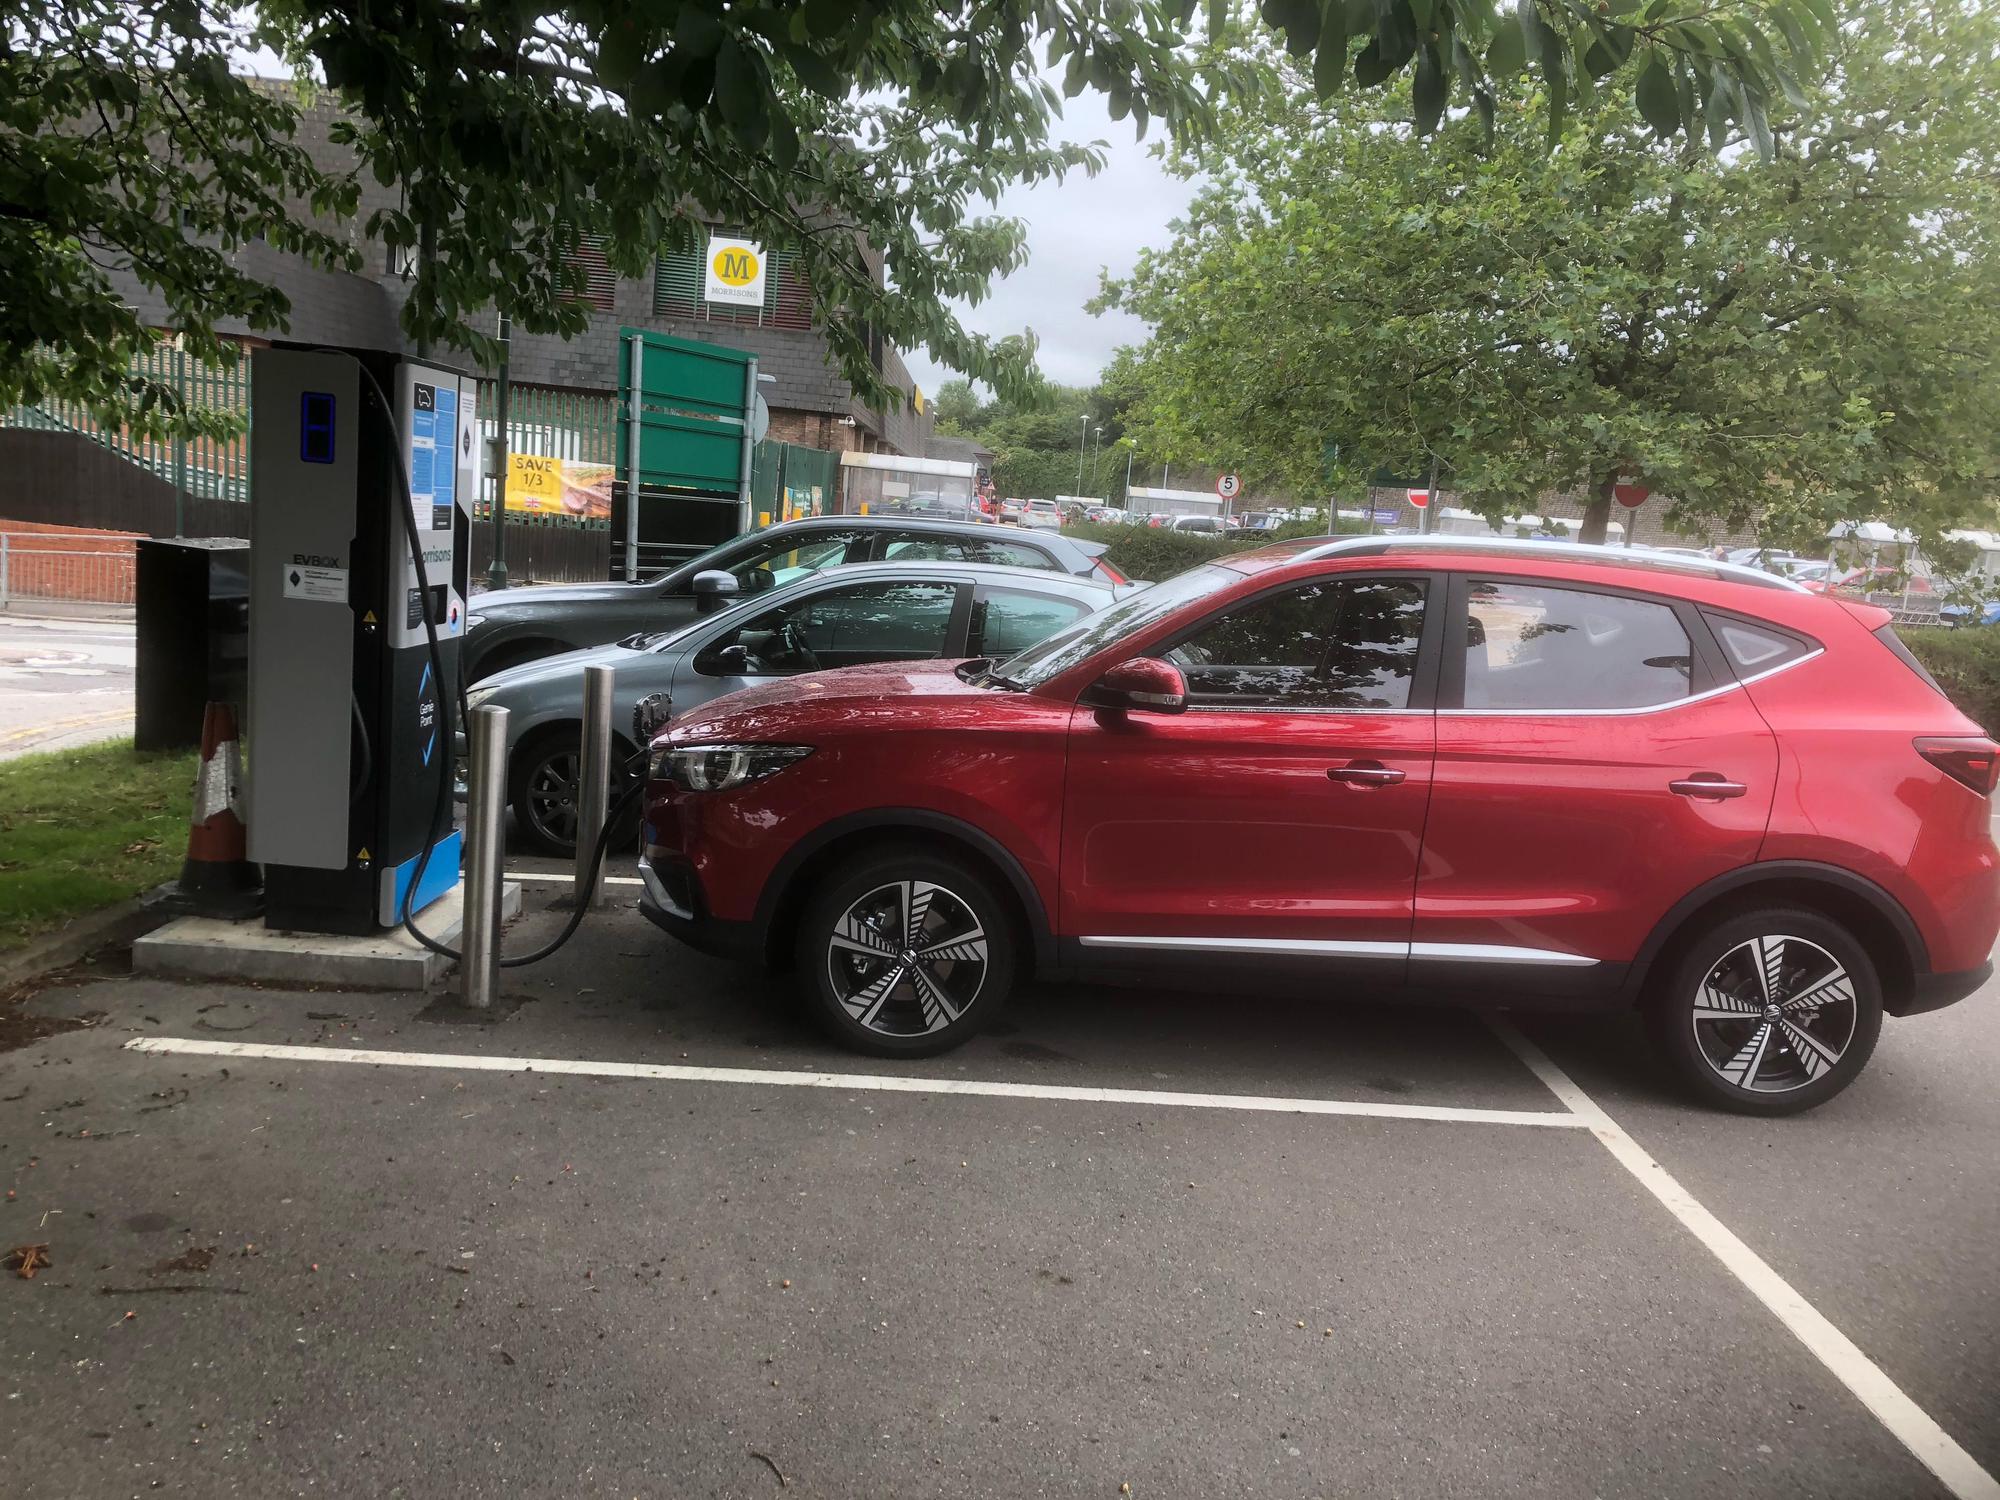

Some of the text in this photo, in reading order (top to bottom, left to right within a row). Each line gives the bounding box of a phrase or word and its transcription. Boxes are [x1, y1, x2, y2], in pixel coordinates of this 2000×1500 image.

[722, 253, 750, 280] M
[711, 287, 759, 298] MORRISONS
[516, 457, 553, 473] SAVE
[523, 473, 543, 487] 1/3
[1224, 477, 1233, 490] 5
[293, 554, 340, 568] EVBOX
[421, 545, 452, 564] orrisons
[420, 715, 433, 728] Point
